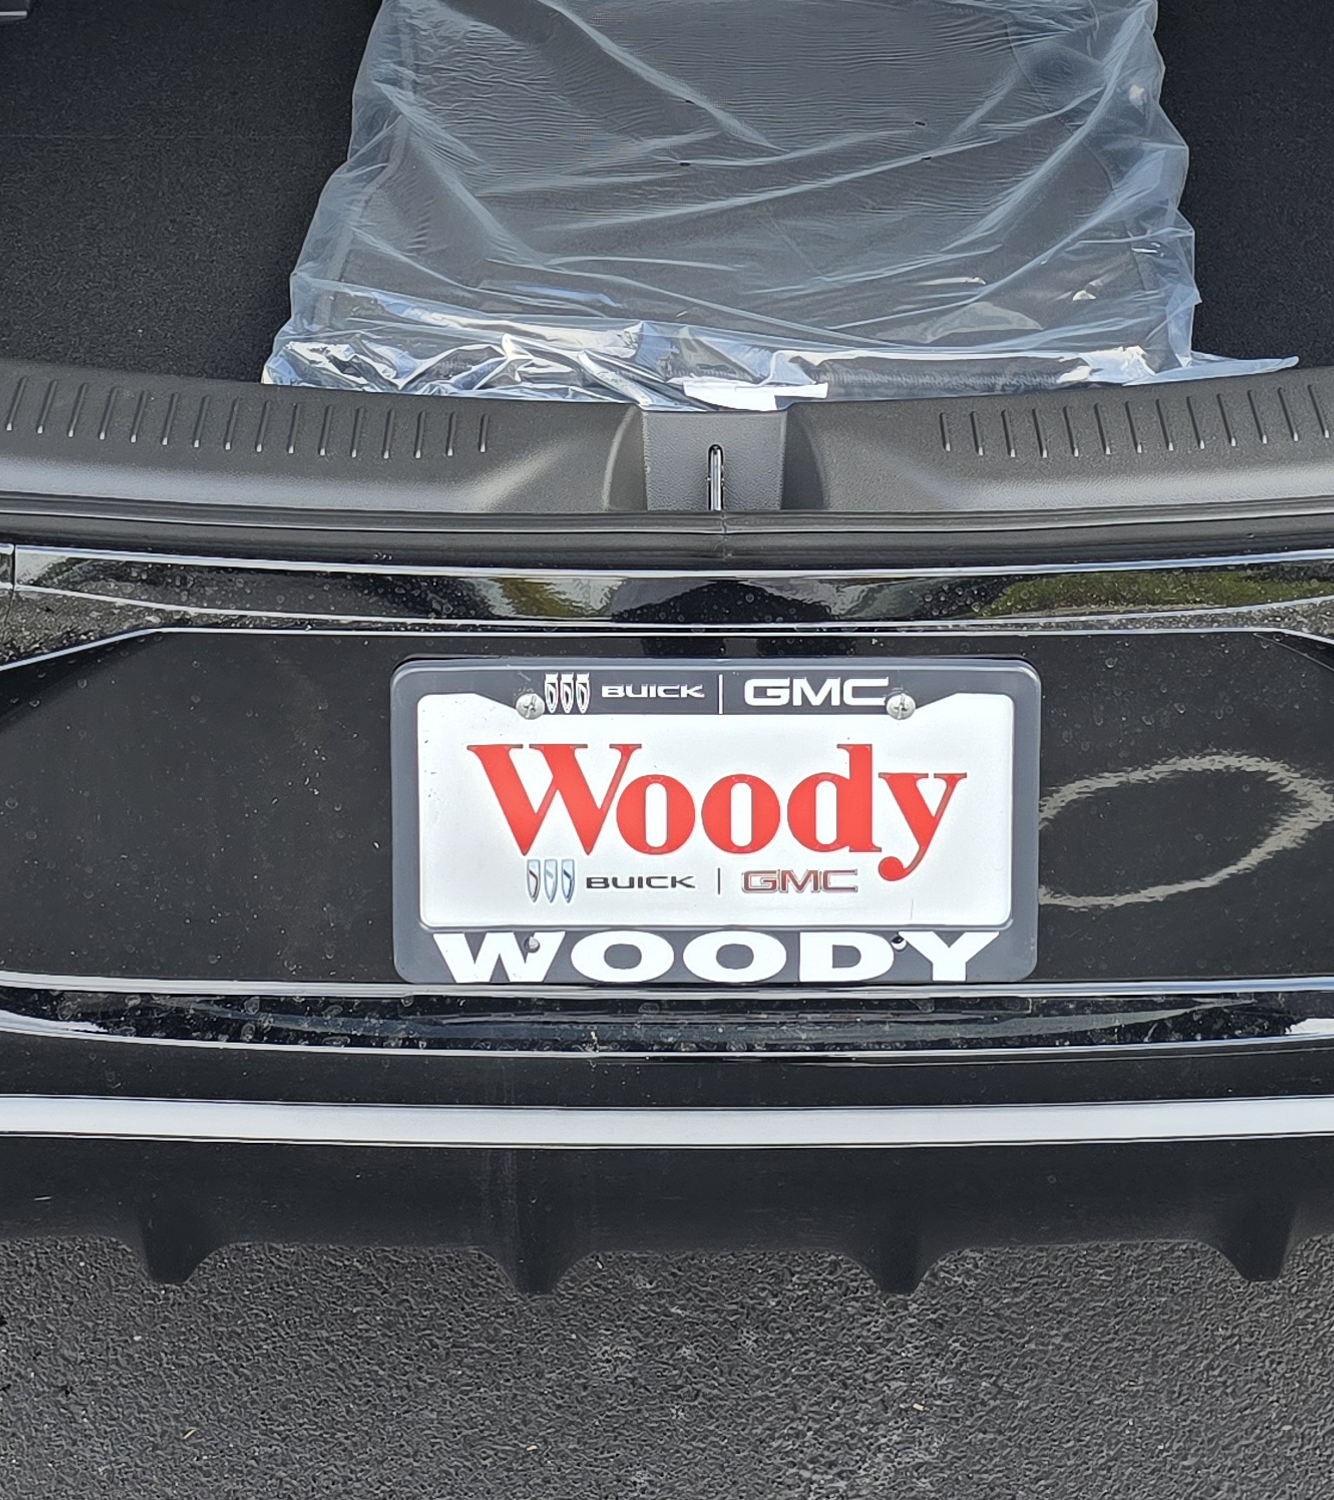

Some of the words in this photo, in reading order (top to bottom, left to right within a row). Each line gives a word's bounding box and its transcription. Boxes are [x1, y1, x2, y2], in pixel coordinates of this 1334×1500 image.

[601, 683, 706, 699] BUICK
[743, 676, 890, 707] GMC
[467, 743, 968, 881] Woody
[585, 875, 696, 890] BUICK
[740, 868, 859, 894] GMC
[432, 930, 1001, 984] WOODY
